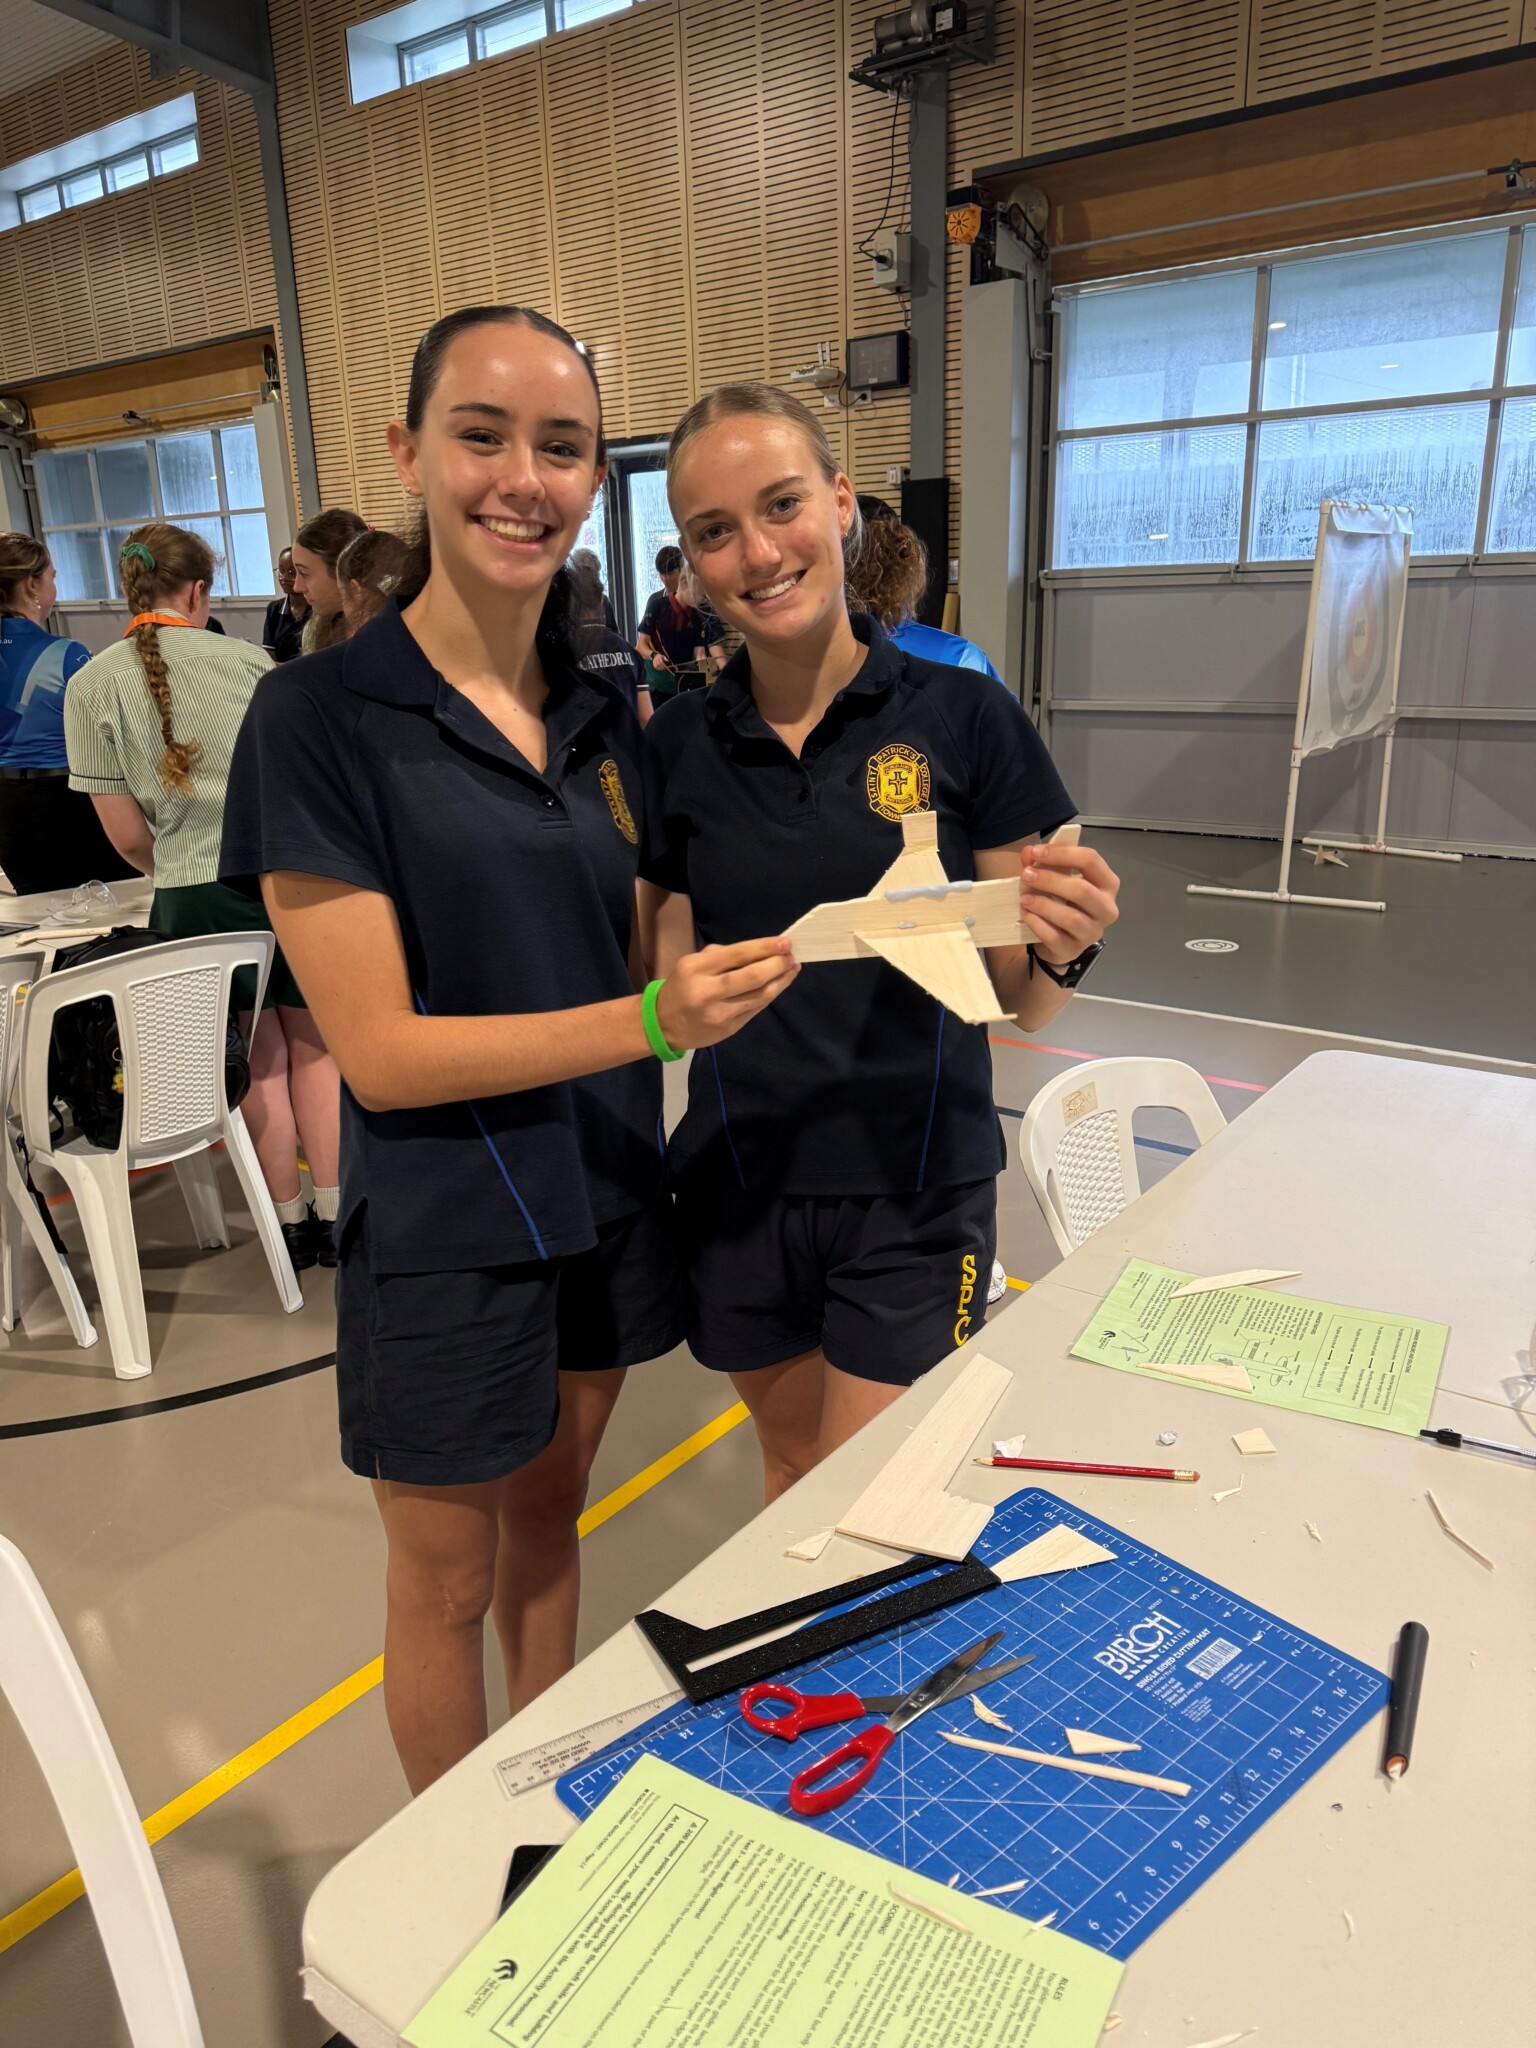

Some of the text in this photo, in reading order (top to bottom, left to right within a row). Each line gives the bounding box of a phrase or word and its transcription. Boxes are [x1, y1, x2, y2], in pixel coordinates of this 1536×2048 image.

[579, 652, 635, 670] CATHEDRAL
[868, 746, 929, 799] SAINT PATRICK'S COLLEGE
[1128, 1559, 1139, 1567] 7
[1091, 1609, 1183, 1675] BIRCH
[1156, 1627, 1191, 1654] CREATIVE
[1134, 1627, 1212, 1688] SINGLE SIDED CUTTING MAT
[1290, 1648, 1302, 1657] 2
[1332, 1686, 1348, 1698] 16
[1311, 1705, 1327, 1718] 15
[677, 1728, 695, 1740] 14
[1289, 1725, 1306, 1739] 14
[1267, 1746, 1284, 1760] 13
[1244, 1768, 1261, 1782] 12
[1219, 1791, 1237, 1805] 11
[1194, 1815, 1212, 1830] 10
[720, 1835, 731, 1845] the
[742, 1838, 755, 1851] Test
[1171, 1840, 1184, 1851] 9
[708, 1843, 725, 1860] glider
[774, 1852, 786, 1864] 200
[697, 1858, 714, 1875] flight.
[727, 1858, 741, 1871] Aim
[733, 1843, 766, 1884] the landing area.
[1144, 1865, 1158, 1878] 8
[720, 1870, 732, 1882] and
[813, 1870, 826, 1883] Test
[706, 1880, 724, 1898] flight
[855, 1888, 868, 1903] Test
[1115, 1890, 1129, 1904] 7
[742, 1888, 761, 1908] points.
[791, 1891, 813, 1918] Precision
[867, 1894, 880, 1909] used
[693, 1897, 713, 1920] control
[505, 1814, 680, 2029] At the end, ensure your team's score sheet is with the Activity Personnel.
[581, 1890, 633, 1949] clip during pack up
[834, 1911, 855, 1938] Distance
[876, 1903, 900, 1936] SCORING
[1088, 1918, 1101, 1931] 6
[521, 1828, 693, 2043] 200 bonus points are awarded for returning the craft knife and bulldog
[775, 1916, 796, 1941] landing
[849, 1915, 868, 1941] calculate
[842, 1940, 854, 1952] the
[830, 1949, 848, 1970] grand
[823, 1968, 837, 1986] total.
[463, 1978, 497, 2015] NEWCASTLE
[1052, 1976, 1068, 2002] RULES
